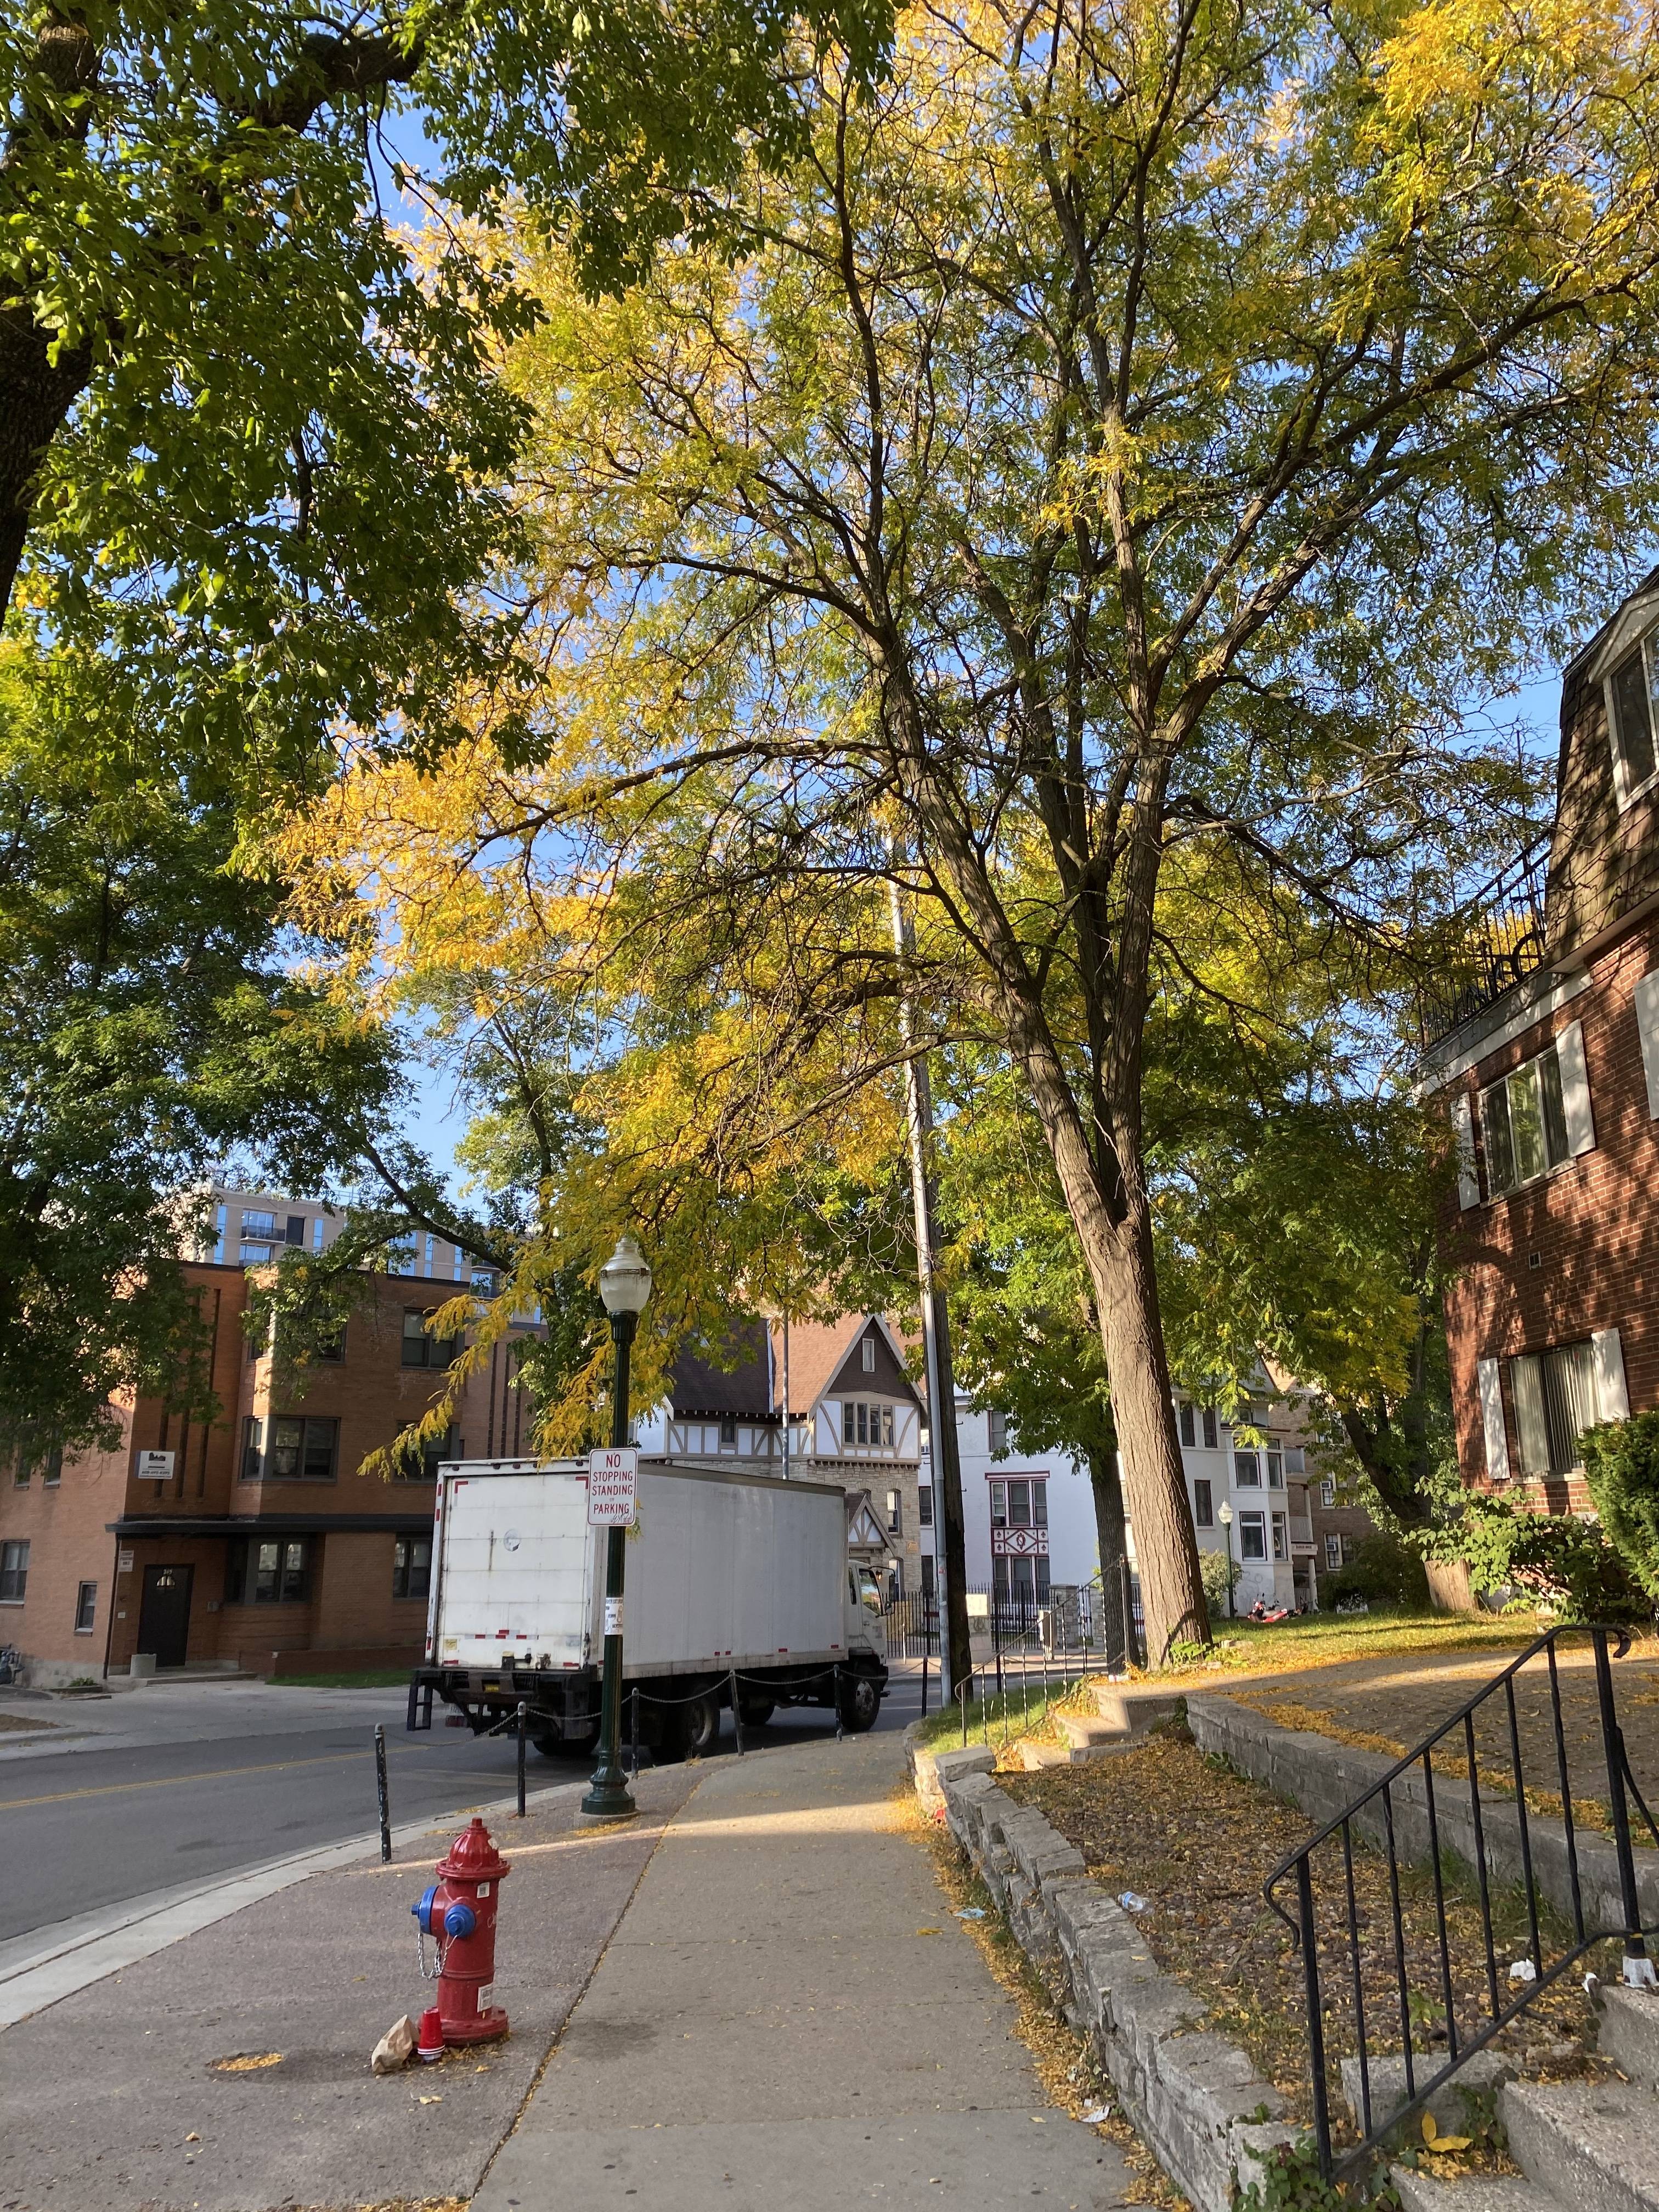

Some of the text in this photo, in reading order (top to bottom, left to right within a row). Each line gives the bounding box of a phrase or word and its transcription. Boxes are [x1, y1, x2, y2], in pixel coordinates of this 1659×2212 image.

[606, 1454, 620, 1468] NO
[592, 1471, 633, 1482] STOPPING
[592, 1485, 633, 1496] STANDING
[594, 1503, 629, 1515] PARKING
